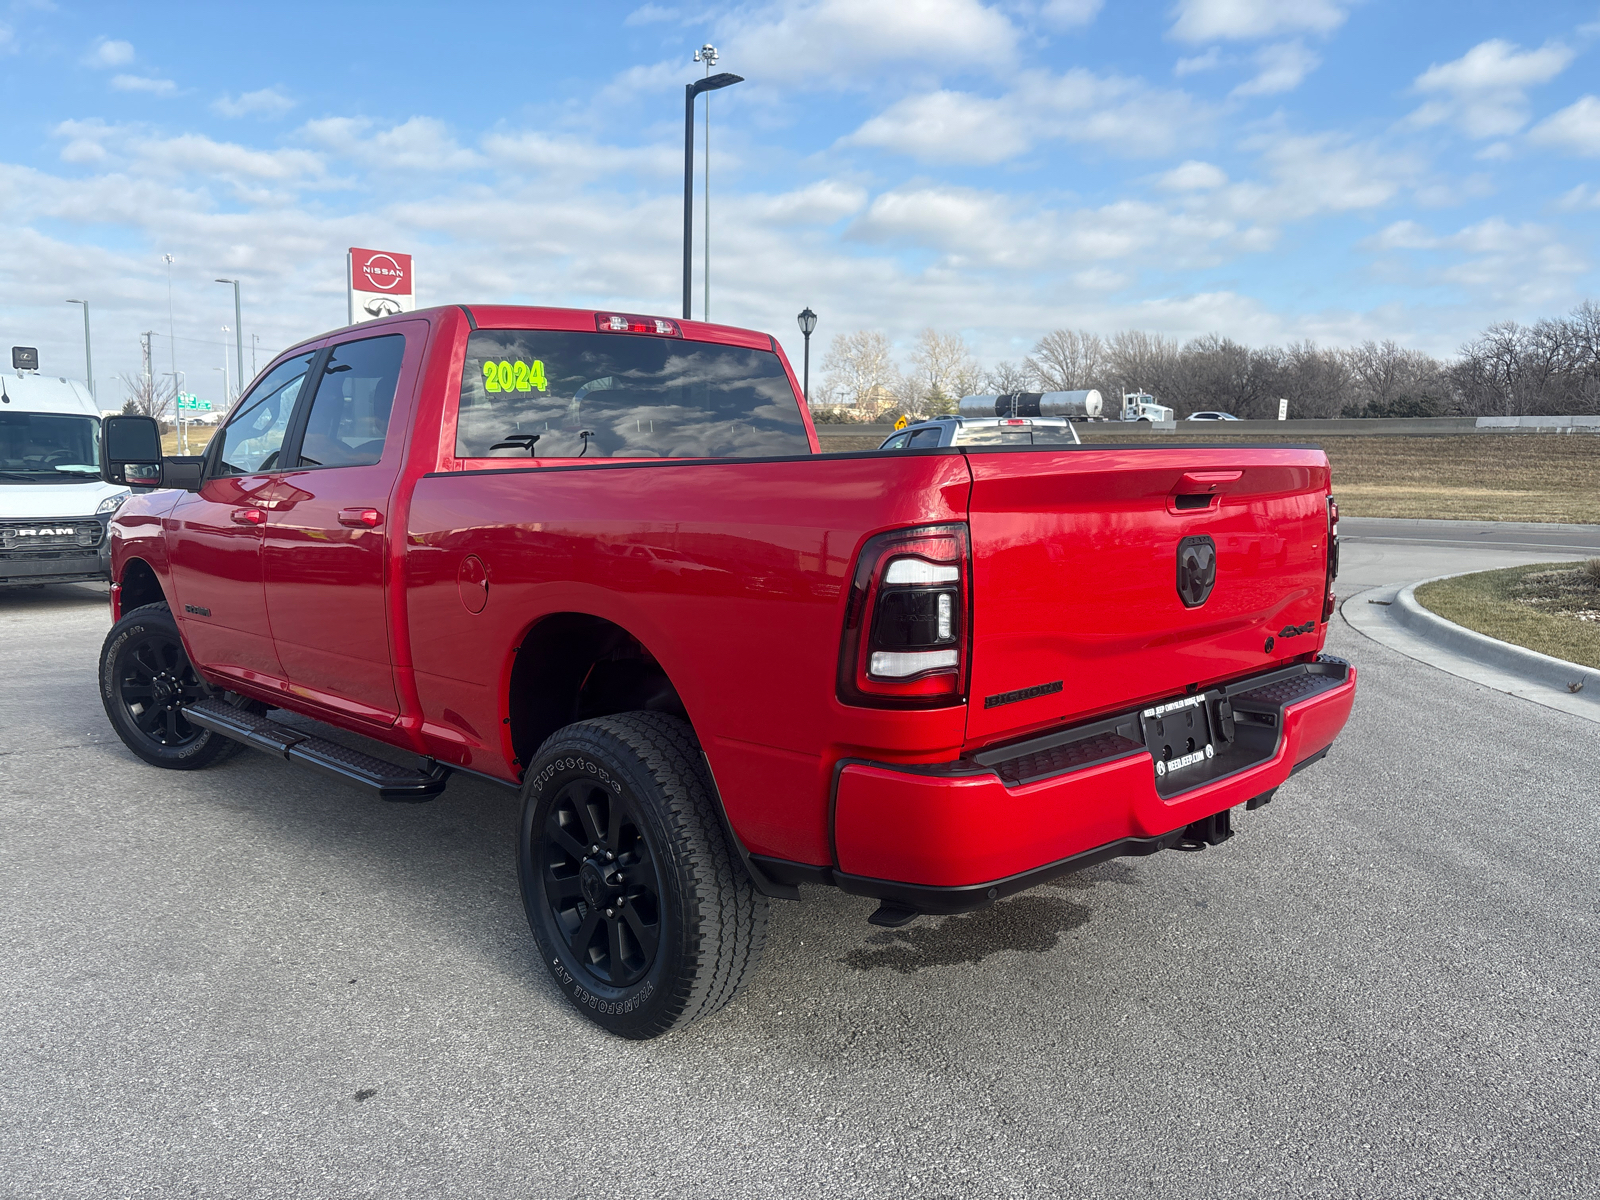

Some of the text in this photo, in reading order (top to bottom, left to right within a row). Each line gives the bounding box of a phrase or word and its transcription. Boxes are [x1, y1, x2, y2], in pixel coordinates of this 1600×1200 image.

[363, 266, 403, 277] NISSAN
[483, 360, 548, 393] 2024
[19, 528, 74, 536] RAM
[1167, 750, 1205, 772] REEDJEEP.COM
[572, 980, 655, 1015] TRANSFORCE
